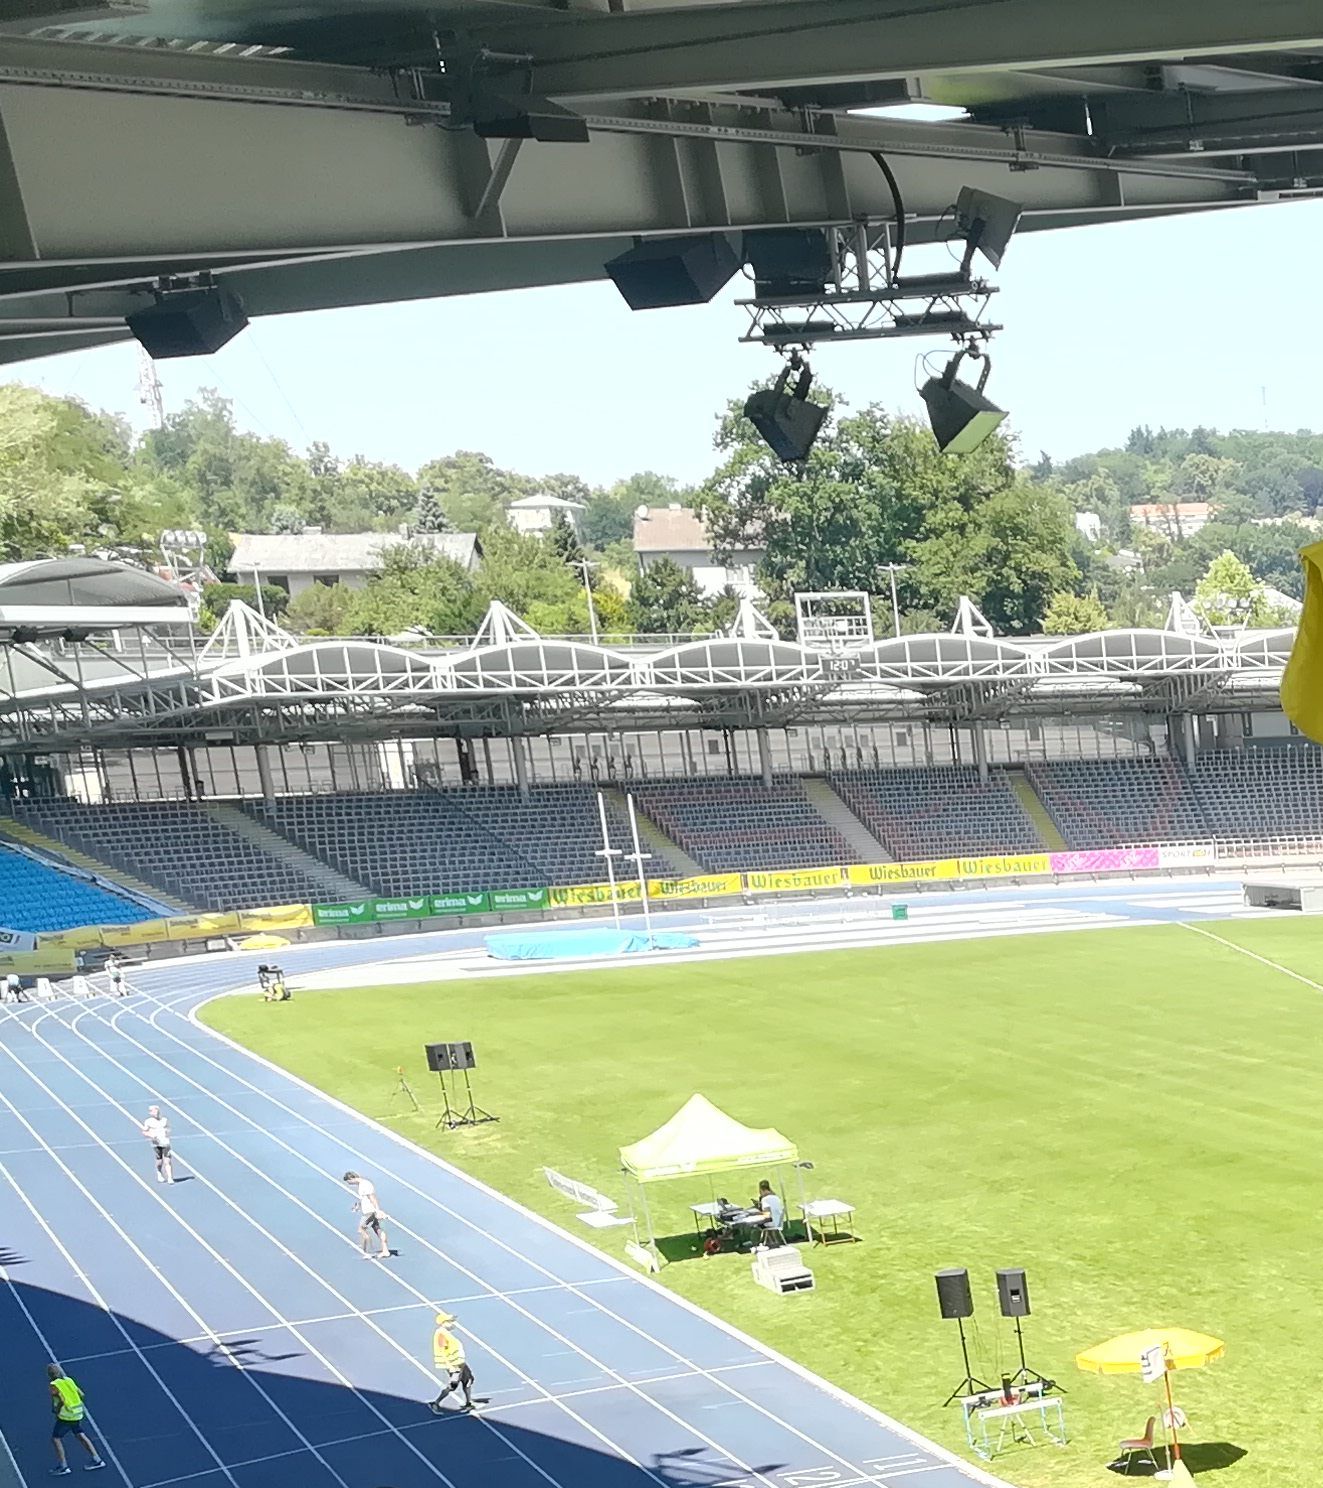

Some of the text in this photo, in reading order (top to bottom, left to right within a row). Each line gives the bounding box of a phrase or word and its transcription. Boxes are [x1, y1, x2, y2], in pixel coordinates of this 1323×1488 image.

[868, 864, 938, 881] Wiesbauer
[961, 857, 1048, 875] Wiesbauer
[750, 872, 839, 890] Wiesbauer
